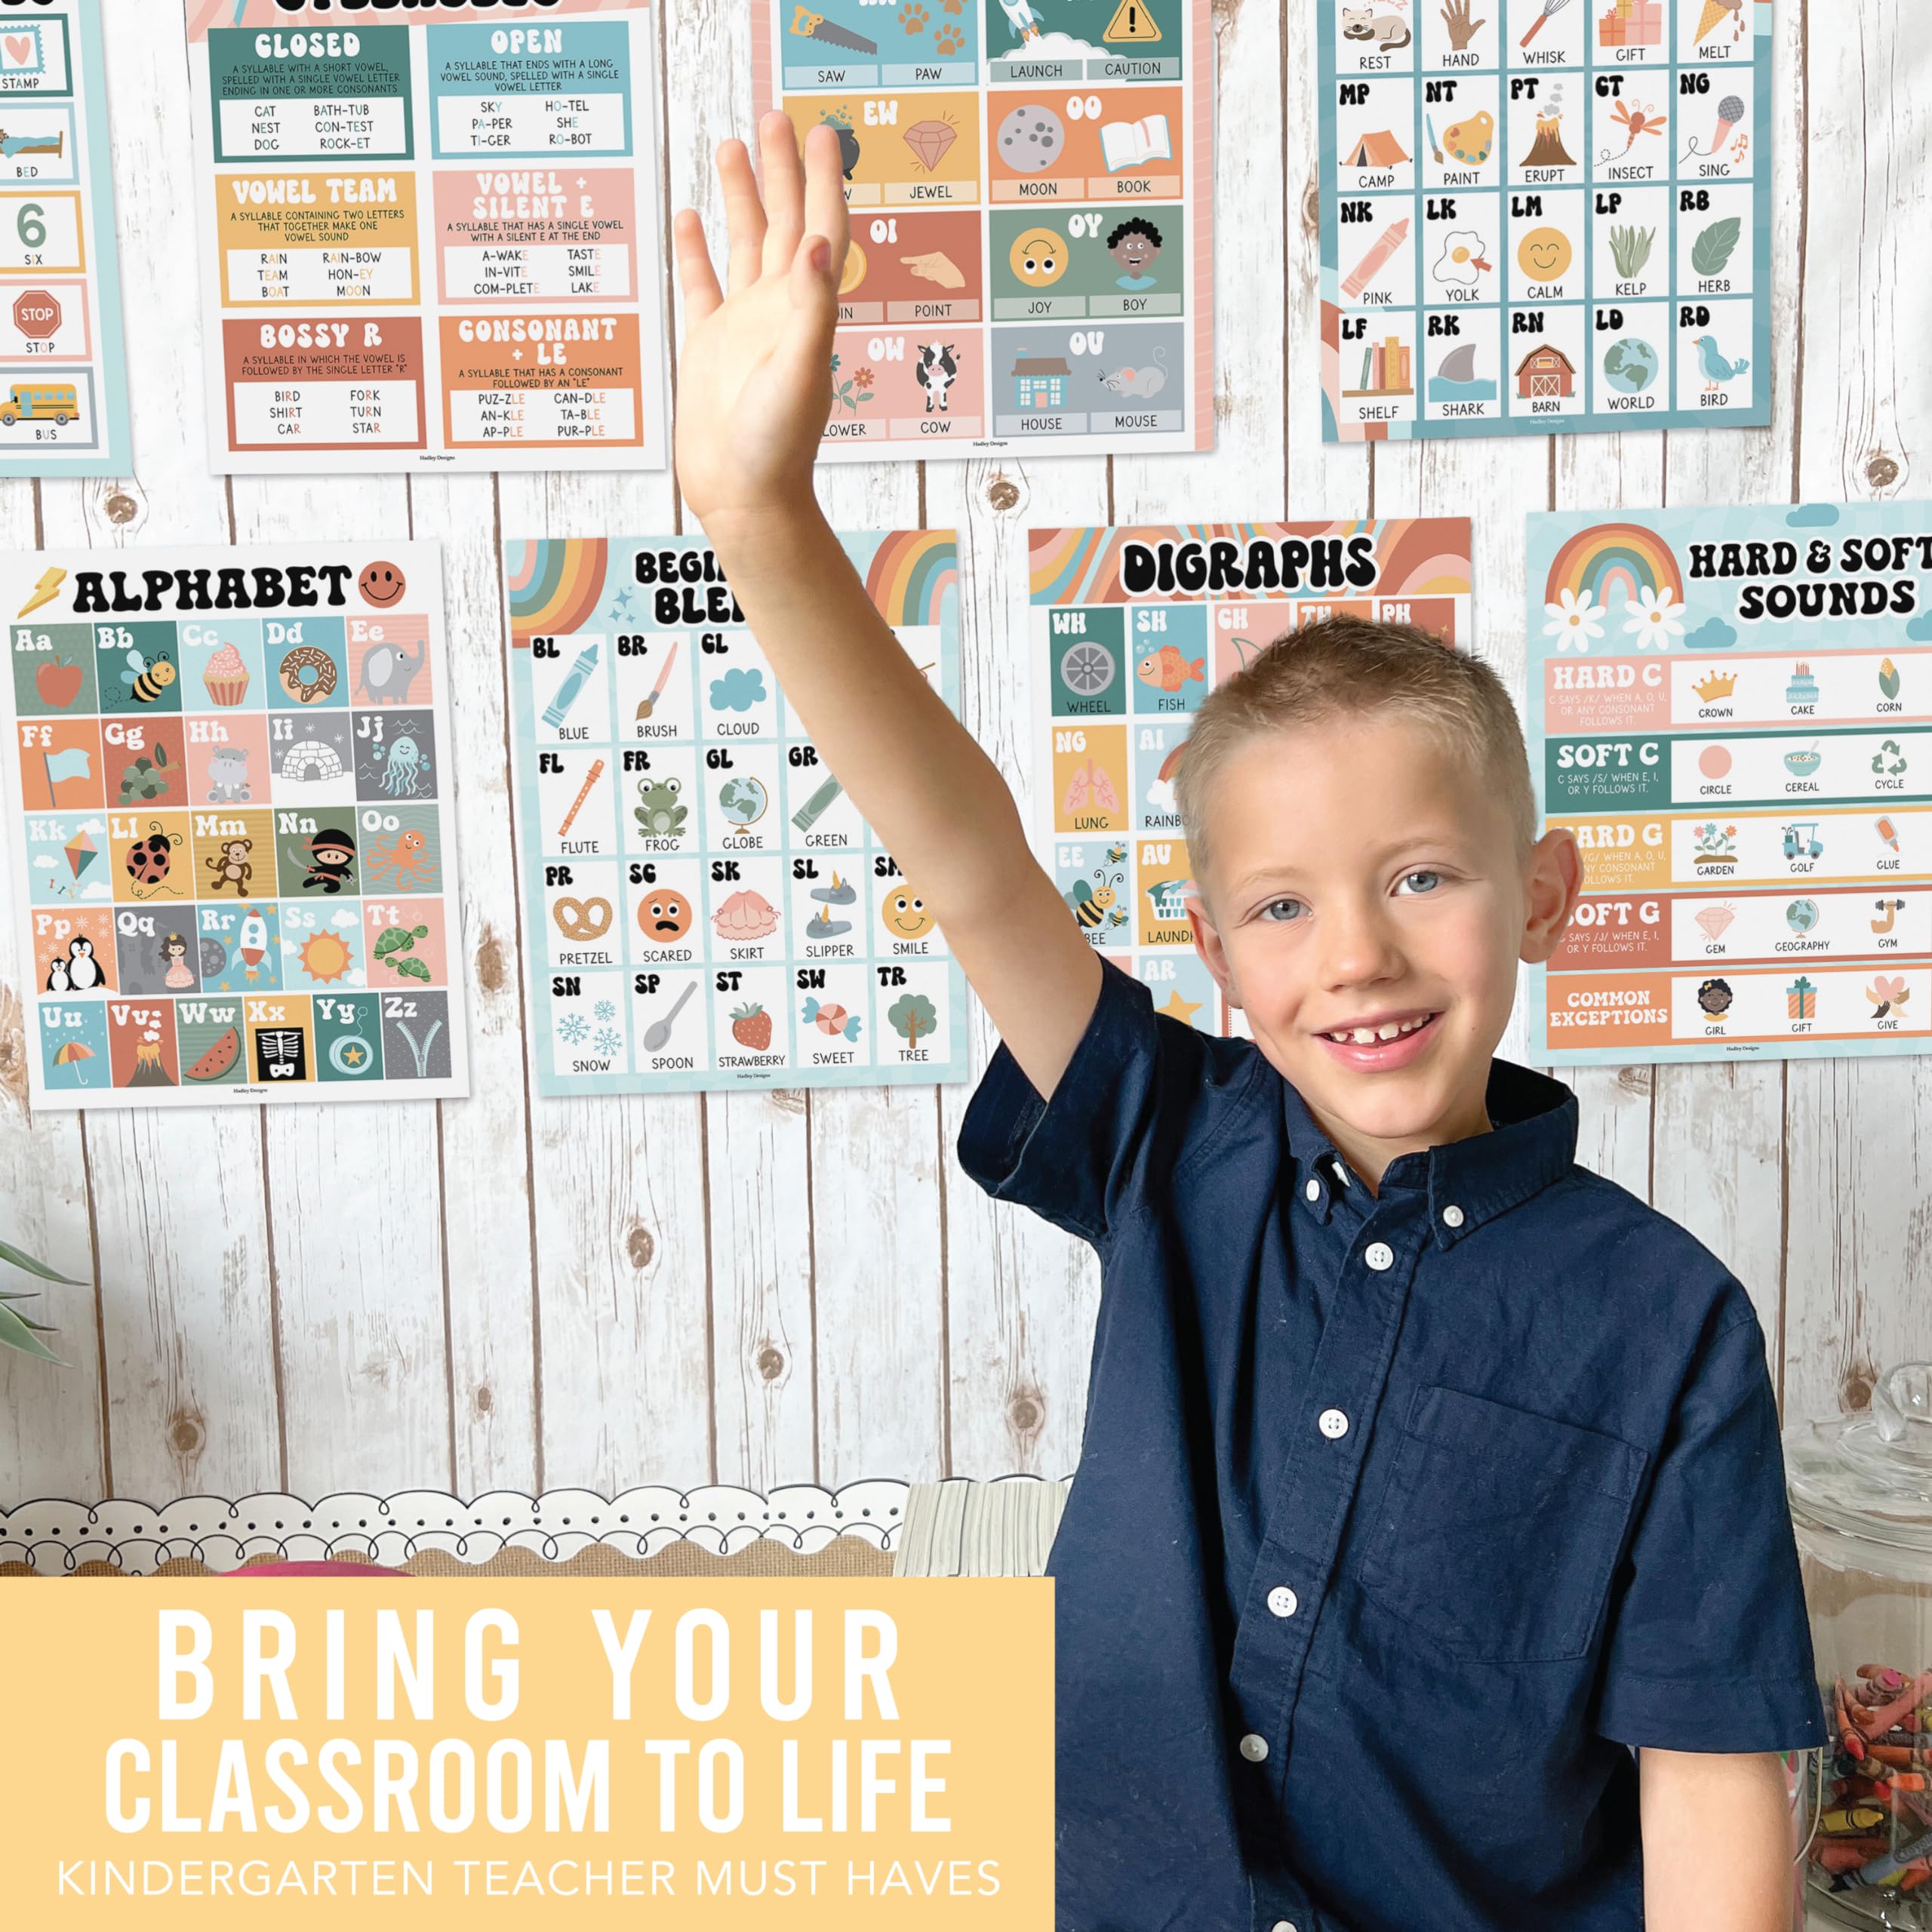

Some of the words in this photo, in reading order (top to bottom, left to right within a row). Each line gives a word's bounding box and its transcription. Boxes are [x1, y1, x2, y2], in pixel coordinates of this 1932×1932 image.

[255, 32, 360, 58] CLOSED
[491, 29, 561, 54] OPEN
[1523, 51, 1565, 63] WHISK
[1617, 48, 1645, 61] GIFT
[1700, 46, 1730, 58] MELT
[454, 61, 497, 70] SYLLABLE
[500, 60, 522, 69] THAT
[527, 60, 549, 69] ENDS
[552, 60, 576, 68] WITH
[589, 60, 613, 68] LONG
[1360, 56, 1391, 69] REST
[1443, 54, 1478, 66] HAND
[916, 68, 942, 80] PAW
[1011, 65, 1062, 78] LAUNCH
[1106, 63, 1160, 75] CAUTION
[441, 72, 471, 82] VOWEL
[475, 72, 506, 82] SOUND,
[511, 72, 548, 80] SPELLED
[552, 71, 574, 79] WITH
[587, 70, 619, 78] SINGLE
[818, 70, 845, 82] SAW
[2, 78, 38, 88] STAMP
[495, 83, 526, 91] VOWEL
[530, 82, 561, 91] LETTER
[1511, 78, 1539, 100] PT
[1595, 75, 1623, 97] CT
[1680, 73, 1709, 94] NG
[1340, 84, 1370, 105] MP
[1426, 81, 1457, 103] NT
[255, 106, 275, 117] CAT
[314, 104, 369, 115] BATH-TUB
[481, 102, 502, 112] SKY
[546, 100, 589, 111] HO-TEL
[1066, 96, 1102, 120] OO
[864, 100, 898, 125] EW
[252, 122, 280, 133] NEST
[315, 121, 374, 132] CON-TEST
[472, 118, 512, 129] PA-PER
[557, 117, 578, 128] SHE
[255, 139, 279, 150] DOG
[321, 137, 370, 149] ROCK-ET
[471, 135, 510, 146] TI-GER
[549, 134, 592, 144] RO-BOT
[17, 167, 38, 177] BED
[1526, 169, 1564, 183] ERUPT
[1609, 166, 1654, 179] INSECT
[1700, 164, 1730, 177] SING
[1359, 175, 1394, 188] CAMP
[1444, 172, 1479, 185] PAINT
[232, 180, 316, 205] VOWEL
[326, 178, 397, 203] TEAM
[910, 186, 952, 198] JEWEL
[1020, 183, 1057, 195] MOON
[1118, 180, 1151, 192] BOOK
[17, 203, 46, 248] 6
[870, 219, 897, 243] OI
[1069, 214, 1103, 238] OY
[25, 254, 42, 265] SIX
[1527, 286, 1562, 298] CALM
[1616, 283, 1646, 295] KELP
[1699, 280, 1730, 292] HERB
[1364, 292, 1392, 304] PINK
[1446, 289, 1479, 301] YOLK
[915, 304, 952, 317] POINT
[1029, 302, 1051, 313] JOY
[1124, 299, 1146, 311] BOY
[22, 308, 54, 321] STOP
[260, 323, 349, 348] BOSSY
[364, 323, 382, 347] R
[459, 318, 617, 342] CONSONANT
[26, 343, 54, 352] STOP
[868, 337, 904, 361] OW
[1069, 331, 1104, 355] OU
[1607, 396, 1654, 410] WORLD
[1701, 394, 1727, 406] BIRD
[1359, 406, 1398, 419] SHELF
[1443, 403, 1484, 416] SHARK
[1533, 401, 1560, 413] BARN
[1022, 418, 1062, 430] HOUSE
[1115, 415, 1157, 427] MOUSE
[921, 422, 951, 433] COW
[36, 429, 57, 440] BUS
[1690, 542, 1797, 577] HARD
[1807, 540, 1830, 573] &
[1124, 538, 1375, 592] DIGRAPHS
[73, 565, 352, 613] ALPHABET
[1740, 580, 1915, 619] SOUNDS
[1053, 613, 1086, 634] WH
[1137, 611, 1167, 632] SH
[1218, 608, 1248, 629] CH
[97, 627, 134, 648] Bb
[1554, 665, 1635, 689] HARD
[1642, 664, 1662, 686] C
[1067, 700, 1111, 712] WHEEL
[1159, 699, 1184, 710] FISH
[1791, 706, 1814, 715] CAKE
[1877, 703, 1901, 712] CORN
[1699, 709, 1732, 718] CROWN
[559, 728, 589, 740] BLUE
[638, 725, 676, 737] BRUSH
[718, 723, 759, 735] CLOUD
[105, 723, 145, 750] Gg
[1557, 743, 1632, 768] SOFT
[1640, 743, 1659, 765] C
[1700, 785, 1731, 795] CIRCLE
[1786, 783, 1819, 792] CEREAL
[1875, 780, 1903, 789] CYCLE
[1075, 817, 1109, 829] LUNG
[646, 839, 679, 851] FROG
[723, 837, 763, 849] GLOBE
[806, 835, 847, 847] GREEN
[561, 841, 598, 854] FLUTE
[1697, 866, 1734, 875] GARDEN
[1791, 863, 1814, 872] GOLF
[1877, 860, 1900, 869] GLUE
[118, 912, 155, 937] Qq
[894, 943, 928, 955] SMILE
[1706, 945, 1725, 953] GEM
[1775, 941, 1829, 951] GEOGRAPHY
[1878, 939, 1897, 948] GYM
[644, 949, 691, 962] SCARED
[731, 947, 764, 959] SKIRT
[807, 945, 854, 957] SLIPPER
[560, 952, 612, 964] PRETZEL
[1567, 990, 1650, 1008] COMMON
[385, 997, 417, 1017] Zz
[1550, 1008, 1667, 1026] EXCEPTIONS
[1706, 1026, 1726, 1035] GIRL
[1792, 1023, 1811, 1032] GIFT
[1878, 1020, 1897, 1029] GIVE
[719, 1056, 785, 1067] STRAWBERRY
[813, 1052, 854, 1064] SWEET
[899, 1050, 928, 1061] TREE
[573, 1060, 610, 1072] SNOW
[652, 1057, 693, 1069] SPOON
